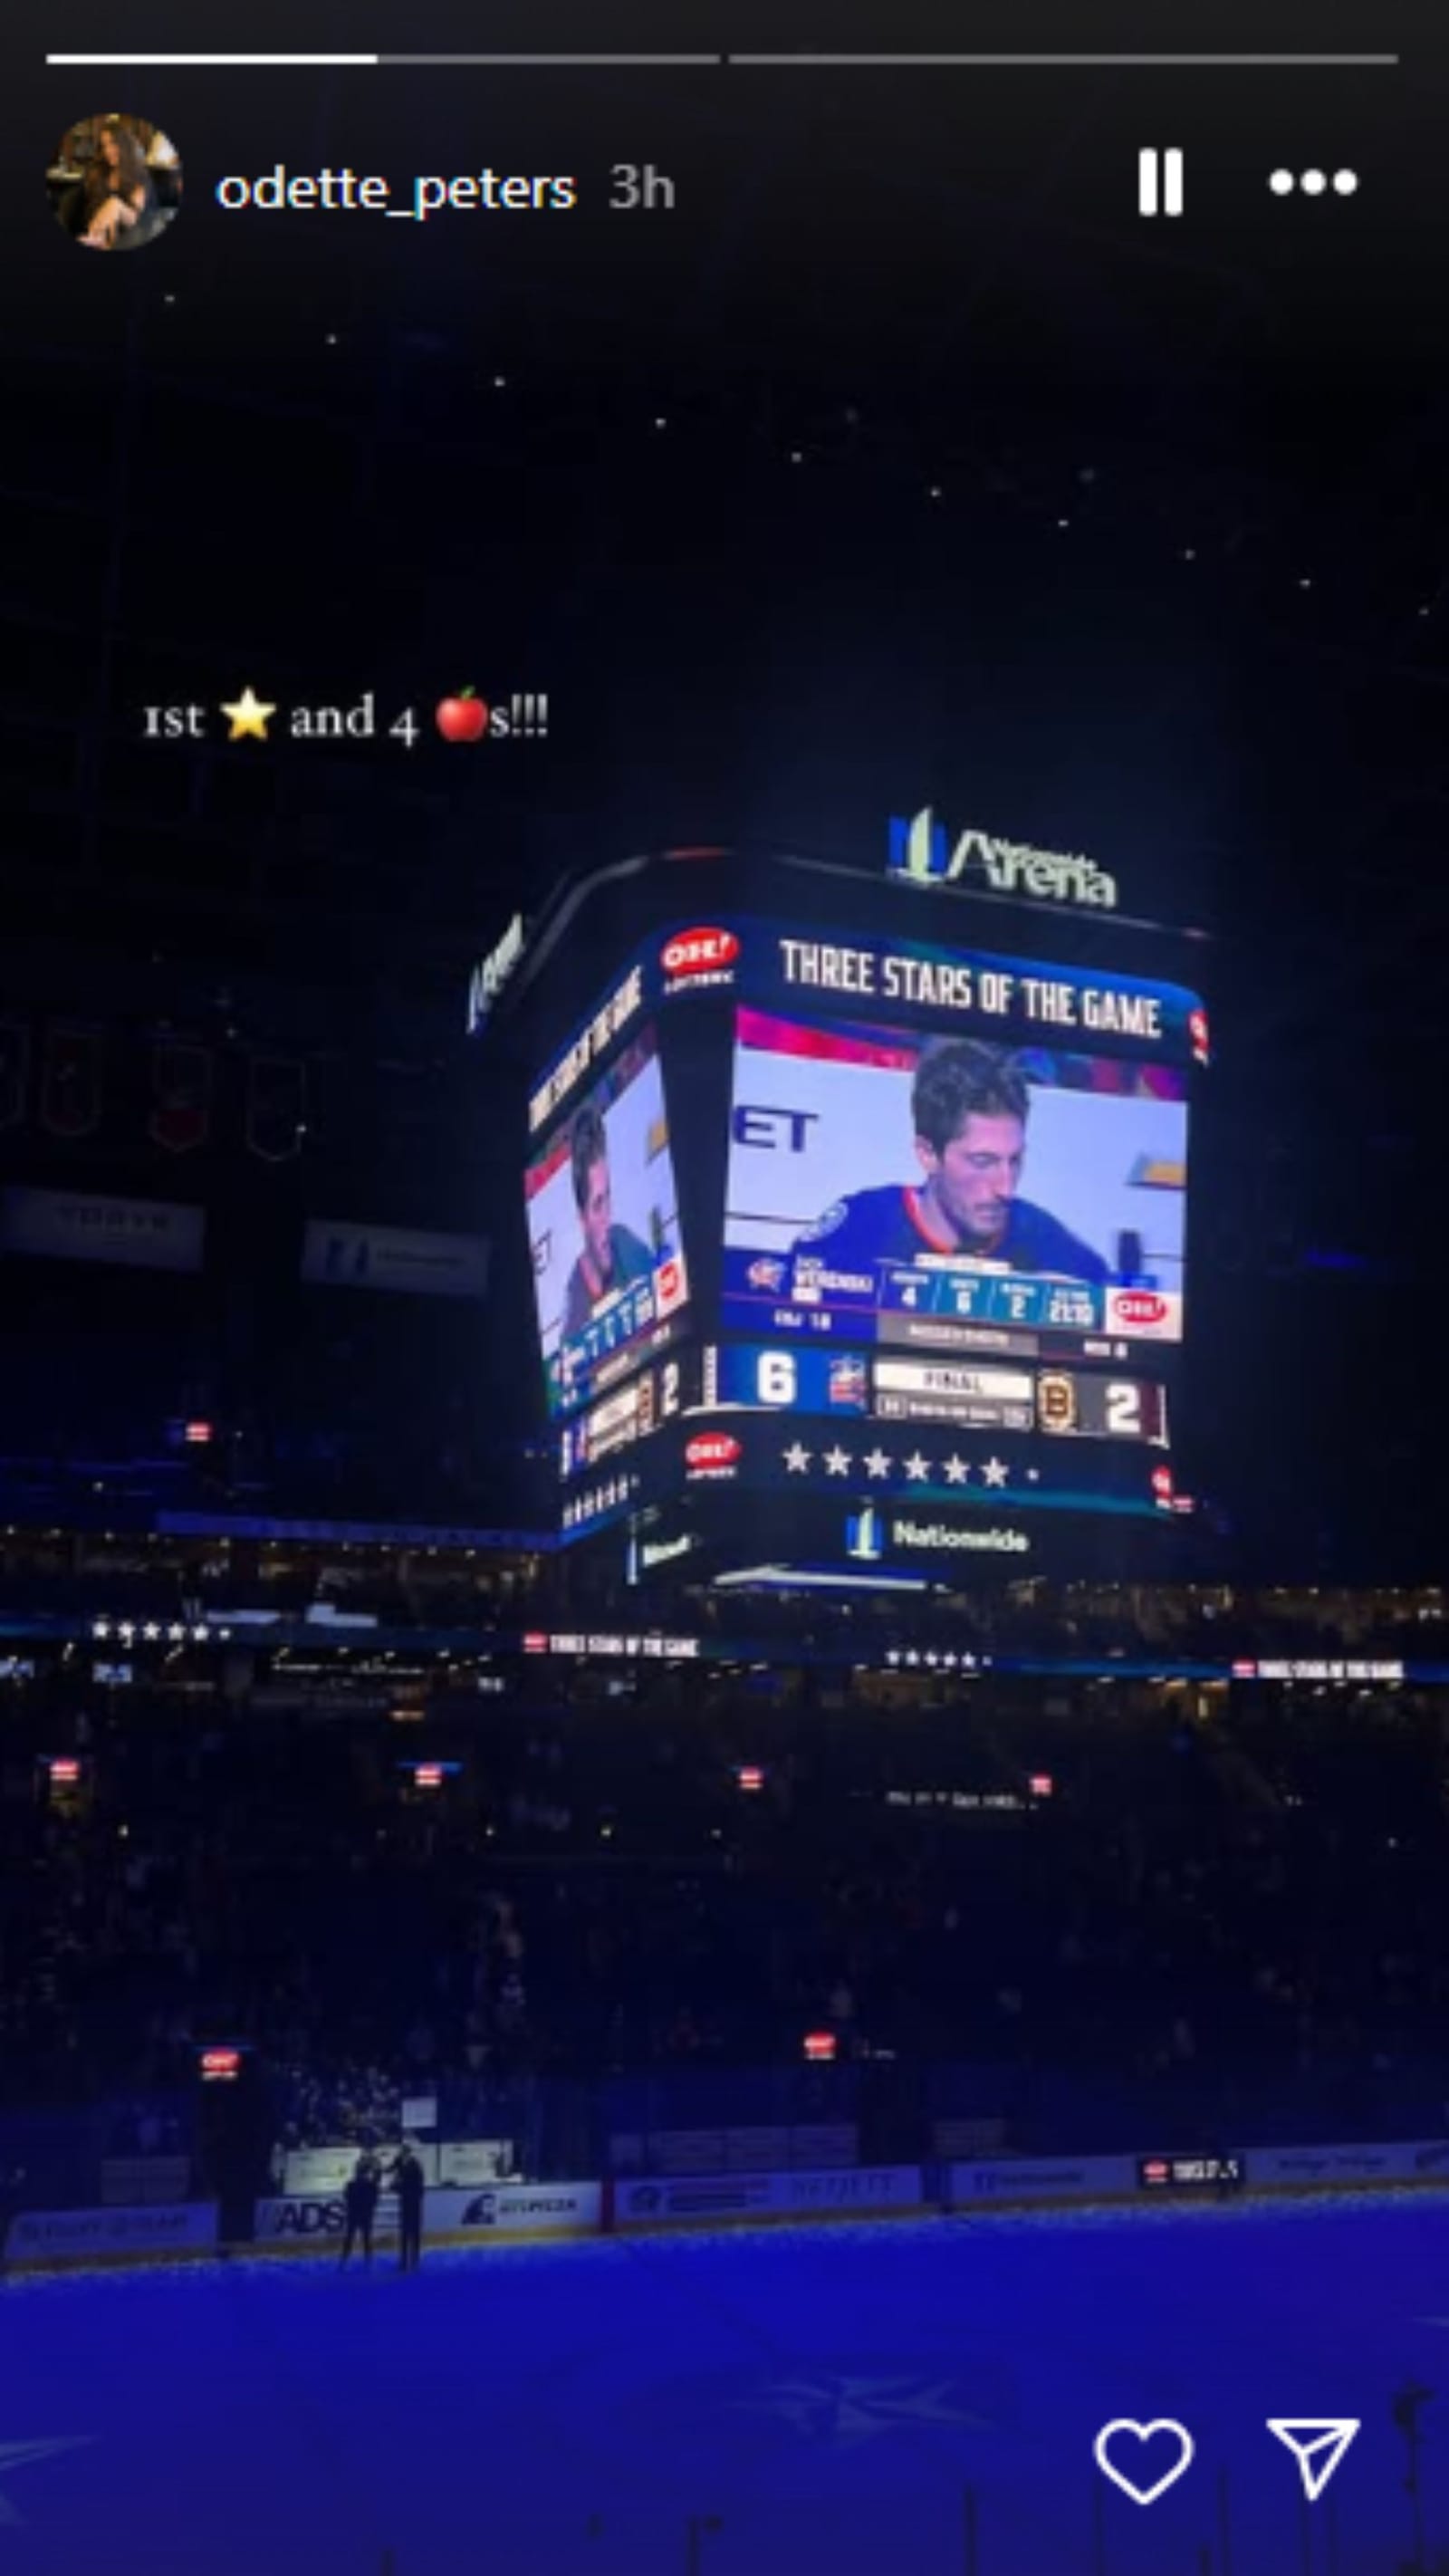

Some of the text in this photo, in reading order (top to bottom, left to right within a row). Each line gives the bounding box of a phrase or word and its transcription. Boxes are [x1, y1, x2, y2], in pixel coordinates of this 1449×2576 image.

[947, 829, 1117, 908] Arena
[662, 931, 730, 967] OH!
[779, 938, 874, 993] THREE
[882, 956, 972, 1008] STARS
[980, 971, 1014, 1014] OF
[1021, 977, 1077, 1026] THE
[1084, 988, 1163, 1039] GAME
[902, 1285, 917, 1308] 4
[1012, 1294, 1027, 1319] 2
[757, 1350, 797, 1405] 6
[1106, 1383, 1142, 1434] 2
[893, 1520, 1031, 1553] Nationwide
